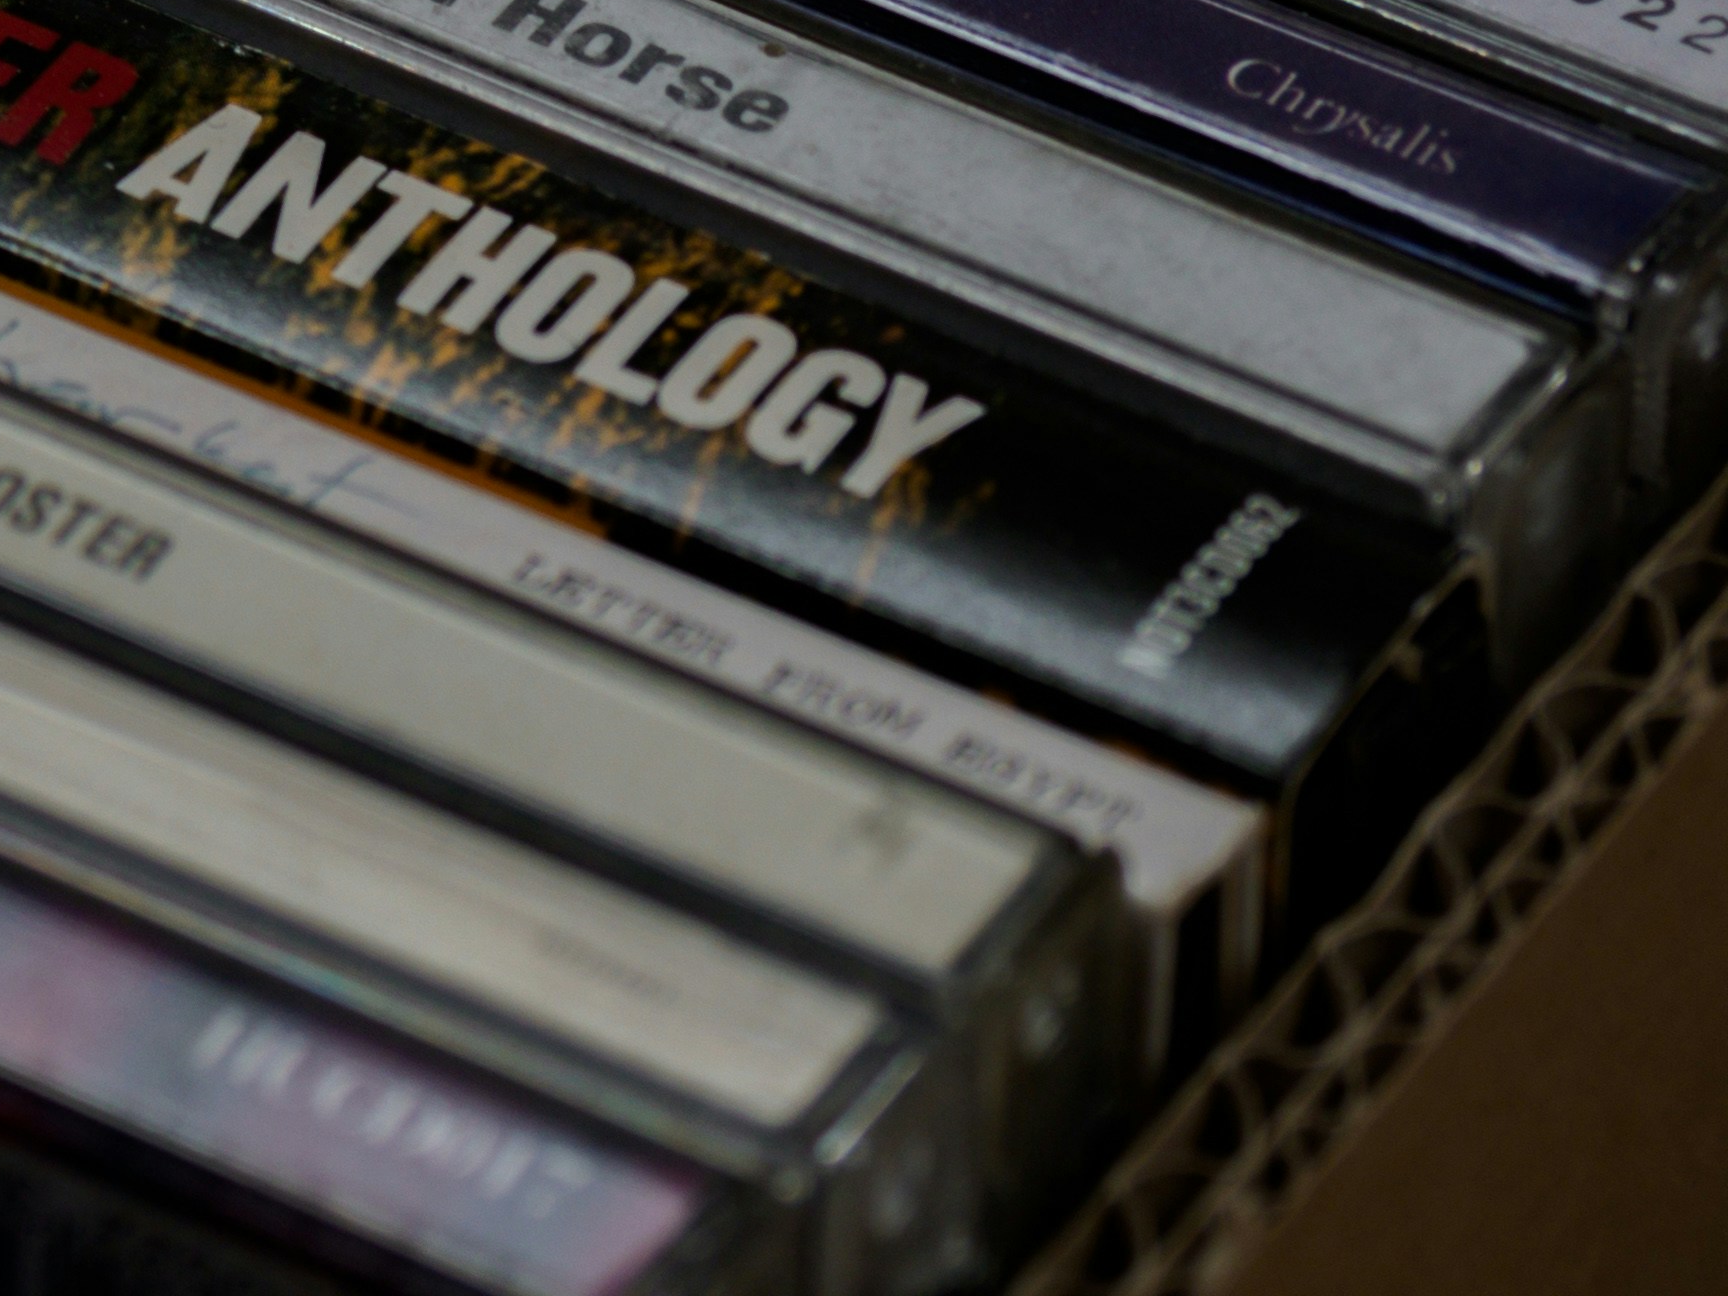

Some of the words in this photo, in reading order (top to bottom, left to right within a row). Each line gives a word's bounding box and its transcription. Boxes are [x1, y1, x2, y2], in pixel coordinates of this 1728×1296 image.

[1224, 54, 1468, 179] Chrysalis
[114, 102, 988, 500] ANTHOLOGY
[512, 552, 739, 669] LETTER
